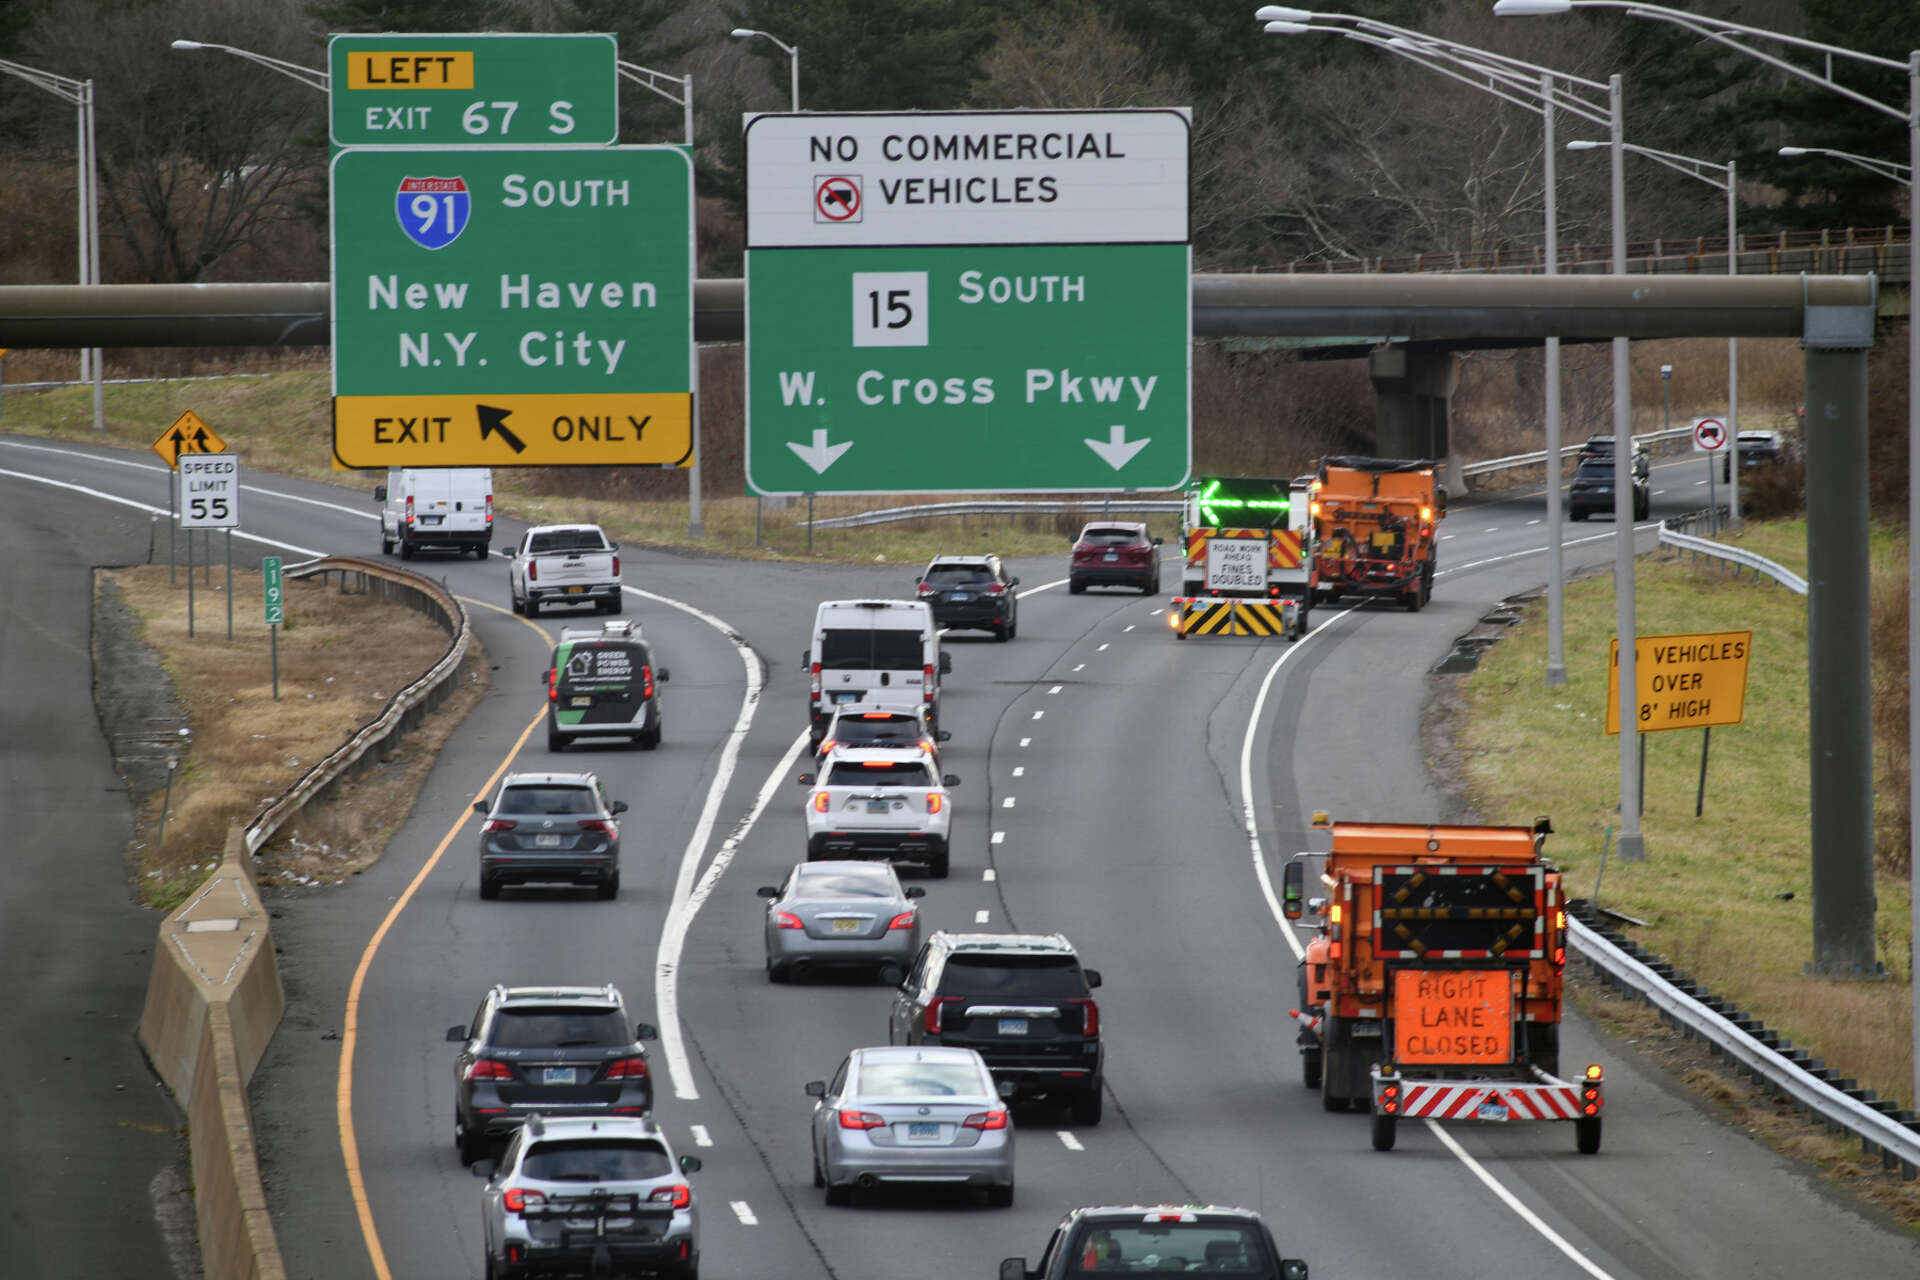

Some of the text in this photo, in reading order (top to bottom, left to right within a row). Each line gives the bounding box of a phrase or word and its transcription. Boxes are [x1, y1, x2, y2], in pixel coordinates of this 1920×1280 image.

[367, 57, 455, 83] LEFT
[366, 101, 576, 135] EXIT 67 S
[810, 132, 1125, 162] NO COMMERCIAL
[407, 180, 459, 191] INTERSTATE
[502, 174, 630, 207] SOUTH
[880, 176, 1059, 205] VEHICLES
[411, 194, 455, 234] 91
[368, 274, 657, 309] New Haven
[958, 270, 1085, 304] SOUTH
[868, 290, 913, 329] 15
[400, 331, 627, 374] N.Y. City
[779, 368, 1158, 411] W. Cross Pkwy
[374, 415, 652, 443] EXIT ONLY
[184, 463, 234, 474] SPEED
[189, 480, 228, 492] LIMIT
[190, 498, 229, 520] 55
[1211, 574, 1263, 585] DOUBLED
[1221, 564, 1253, 574] FINES
[1653, 641, 1745, 665] VEHICLES
[1652, 673, 1703, 693] OVER
[1640, 699, 1711, 721] 8' HIGH
[1417, 979, 1487, 1000] RIGHT
[1420, 1006, 1485, 1028] LANE
[1406, 1035, 1499, 1056] CLOSED
